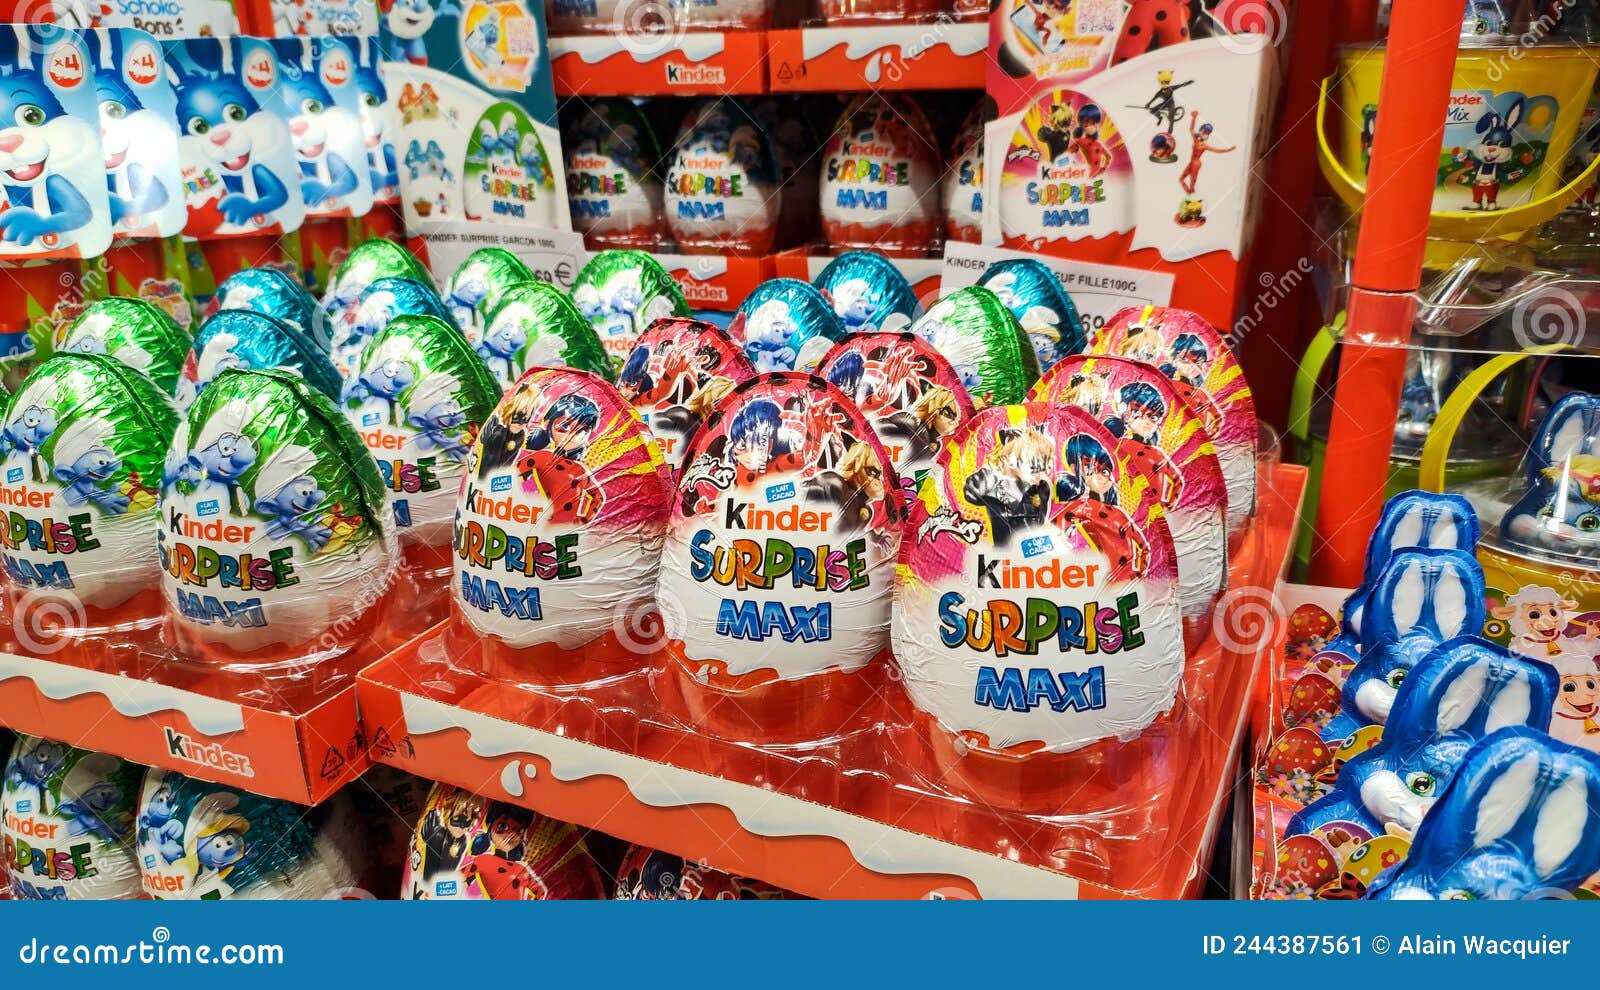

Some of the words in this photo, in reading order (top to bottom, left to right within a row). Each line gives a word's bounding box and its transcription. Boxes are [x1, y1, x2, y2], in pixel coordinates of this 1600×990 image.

[668, 171, 744, 199] SURPRISE
[827, 157, 910, 187] SURPRISE
[836, 188, 887, 211] MAXI
[1026, 179, 1106, 207] SURPRISE
[1042, 208, 1090, 228] MAXI
[946, 256, 986, 270] KINDER
[1078, 274, 1137, 293] FILLE100G
[690, 528, 870, 593] SURPRISE
[177, 587, 268, 629] MAXI
[462, 570, 543, 621] MAXI
[715, 598, 833, 644] MAXI
[938, 591, 1146, 658] SURPRISE
[974, 666, 1106, 714] MAXI
